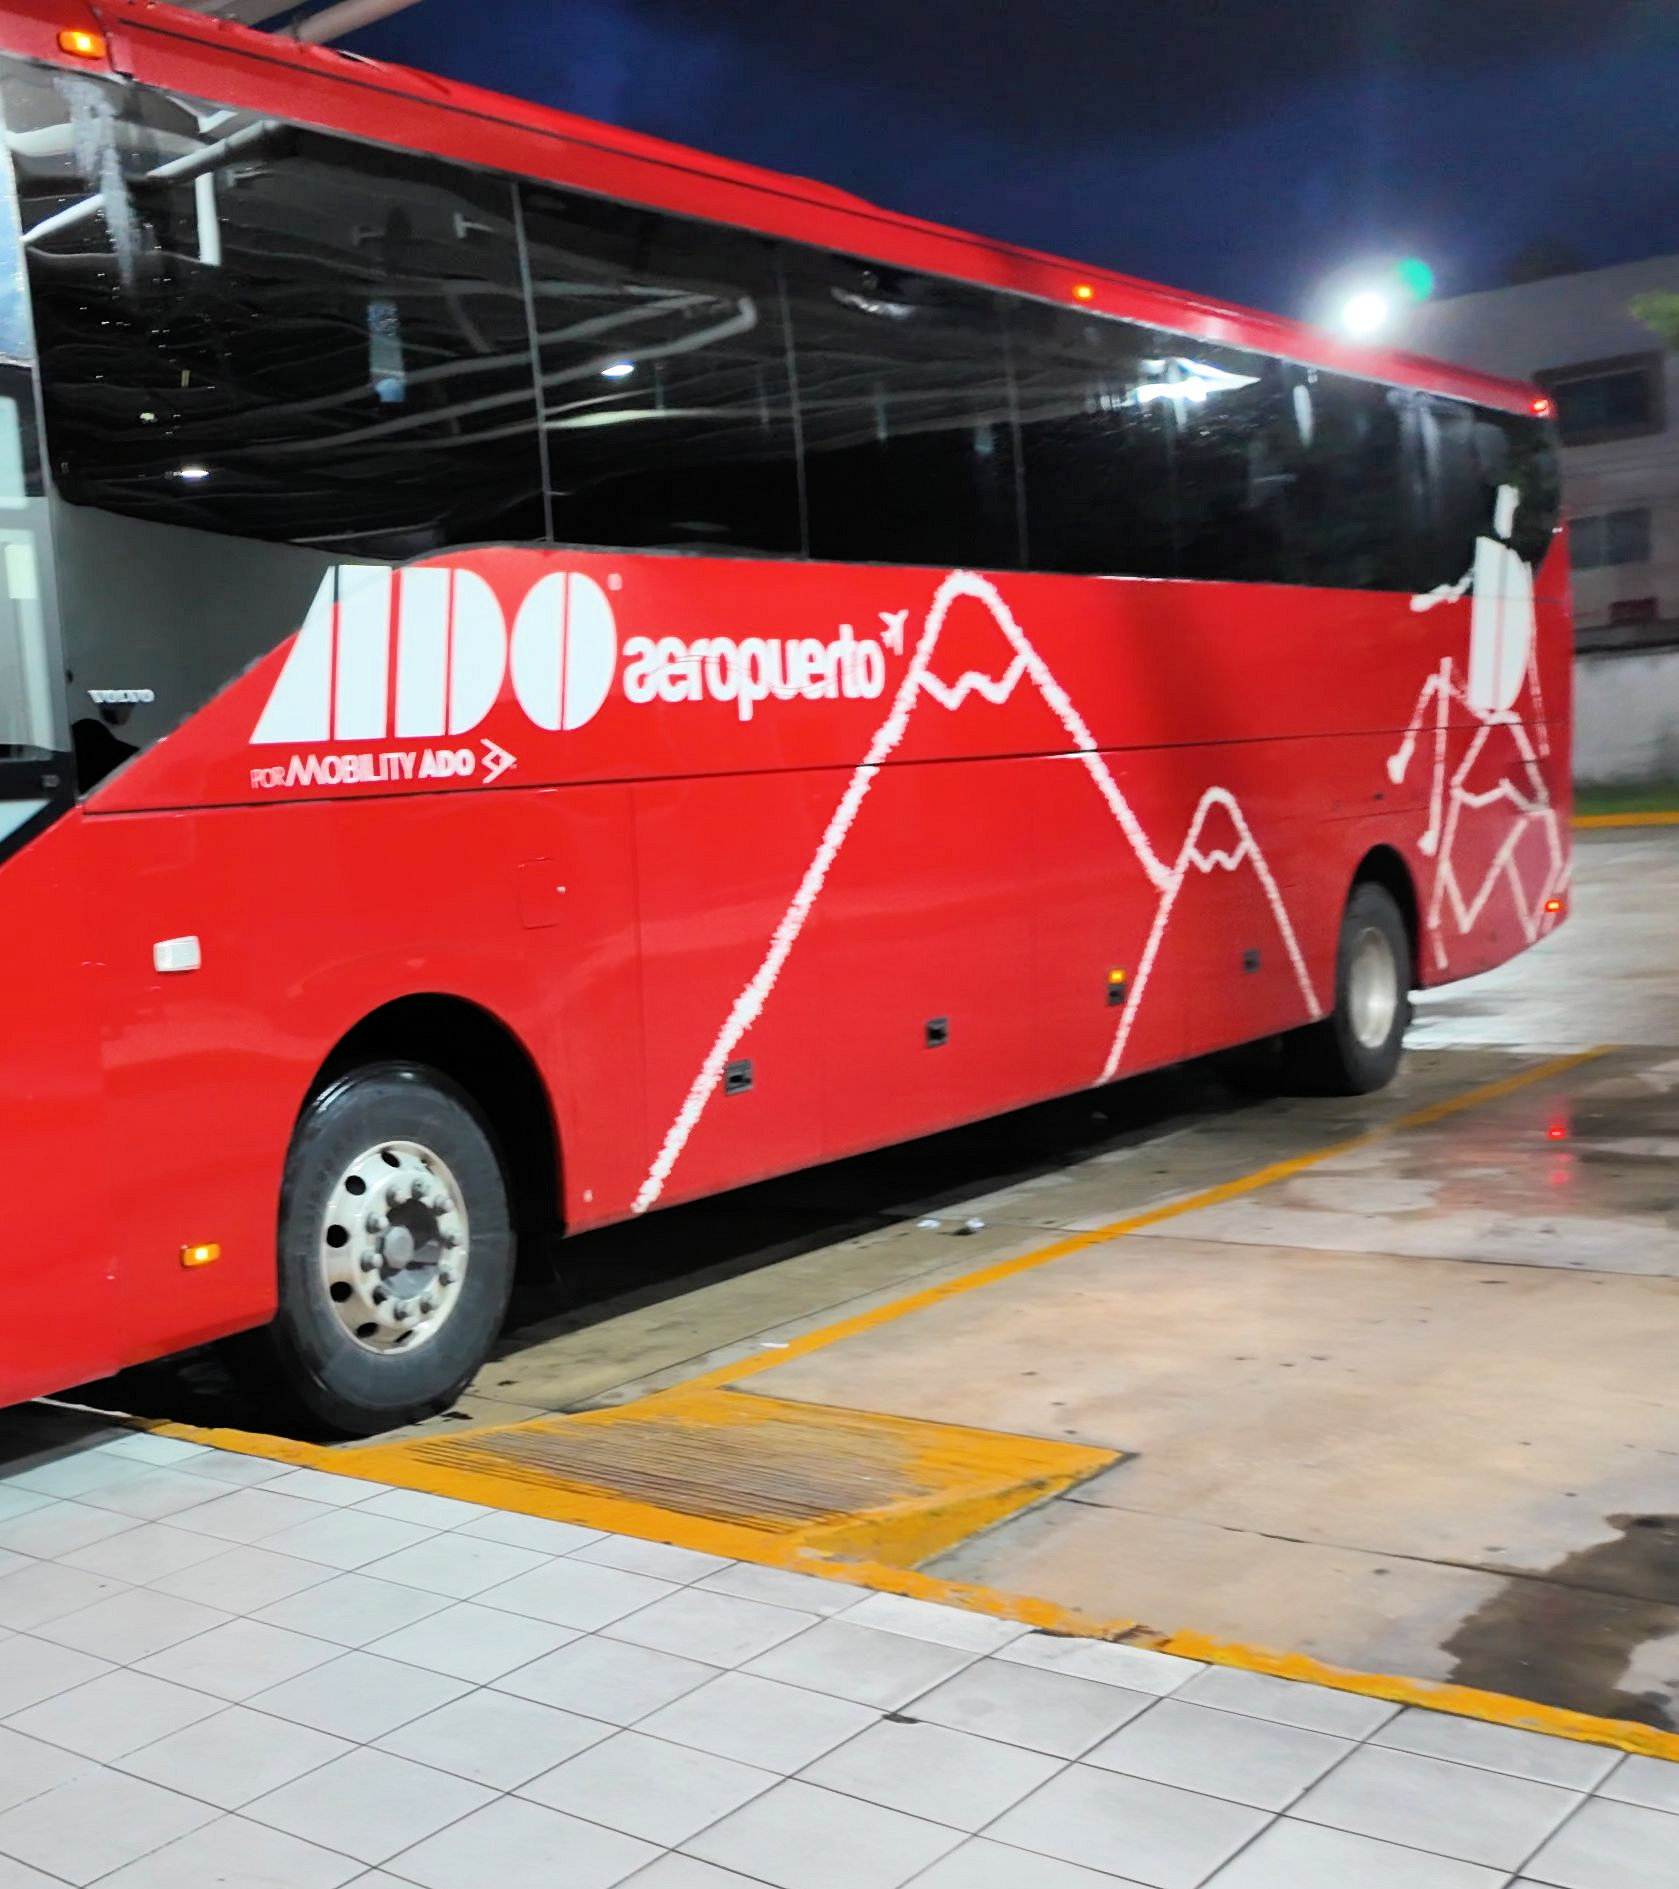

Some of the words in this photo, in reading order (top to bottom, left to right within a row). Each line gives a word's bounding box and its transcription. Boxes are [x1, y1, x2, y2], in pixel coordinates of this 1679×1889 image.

[249, 564, 618, 744] ADO
[623, 623, 886, 721] aeropuerto
[284, 752, 417, 787] MOBILITY
[418, 749, 476, 779] ADO
